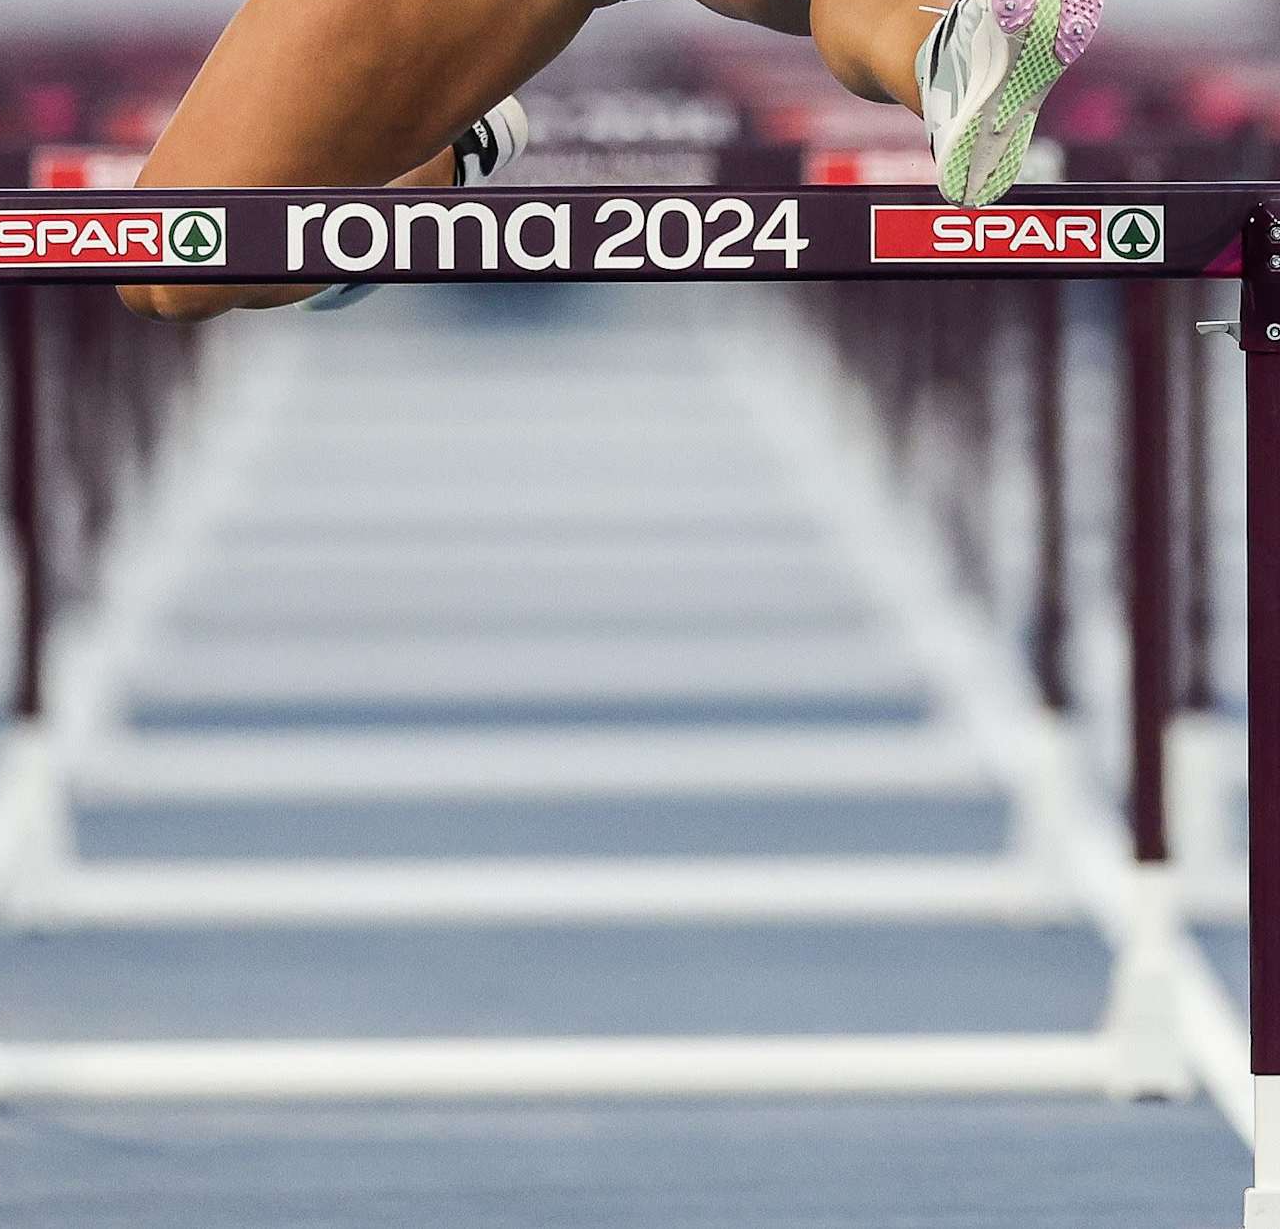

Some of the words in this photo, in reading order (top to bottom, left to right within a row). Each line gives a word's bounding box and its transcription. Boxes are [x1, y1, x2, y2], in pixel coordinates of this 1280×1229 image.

[286, 202, 571, 271] roma
[592, 199, 810, 270] 2024
[932, 215, 1097, 253] SPAR
